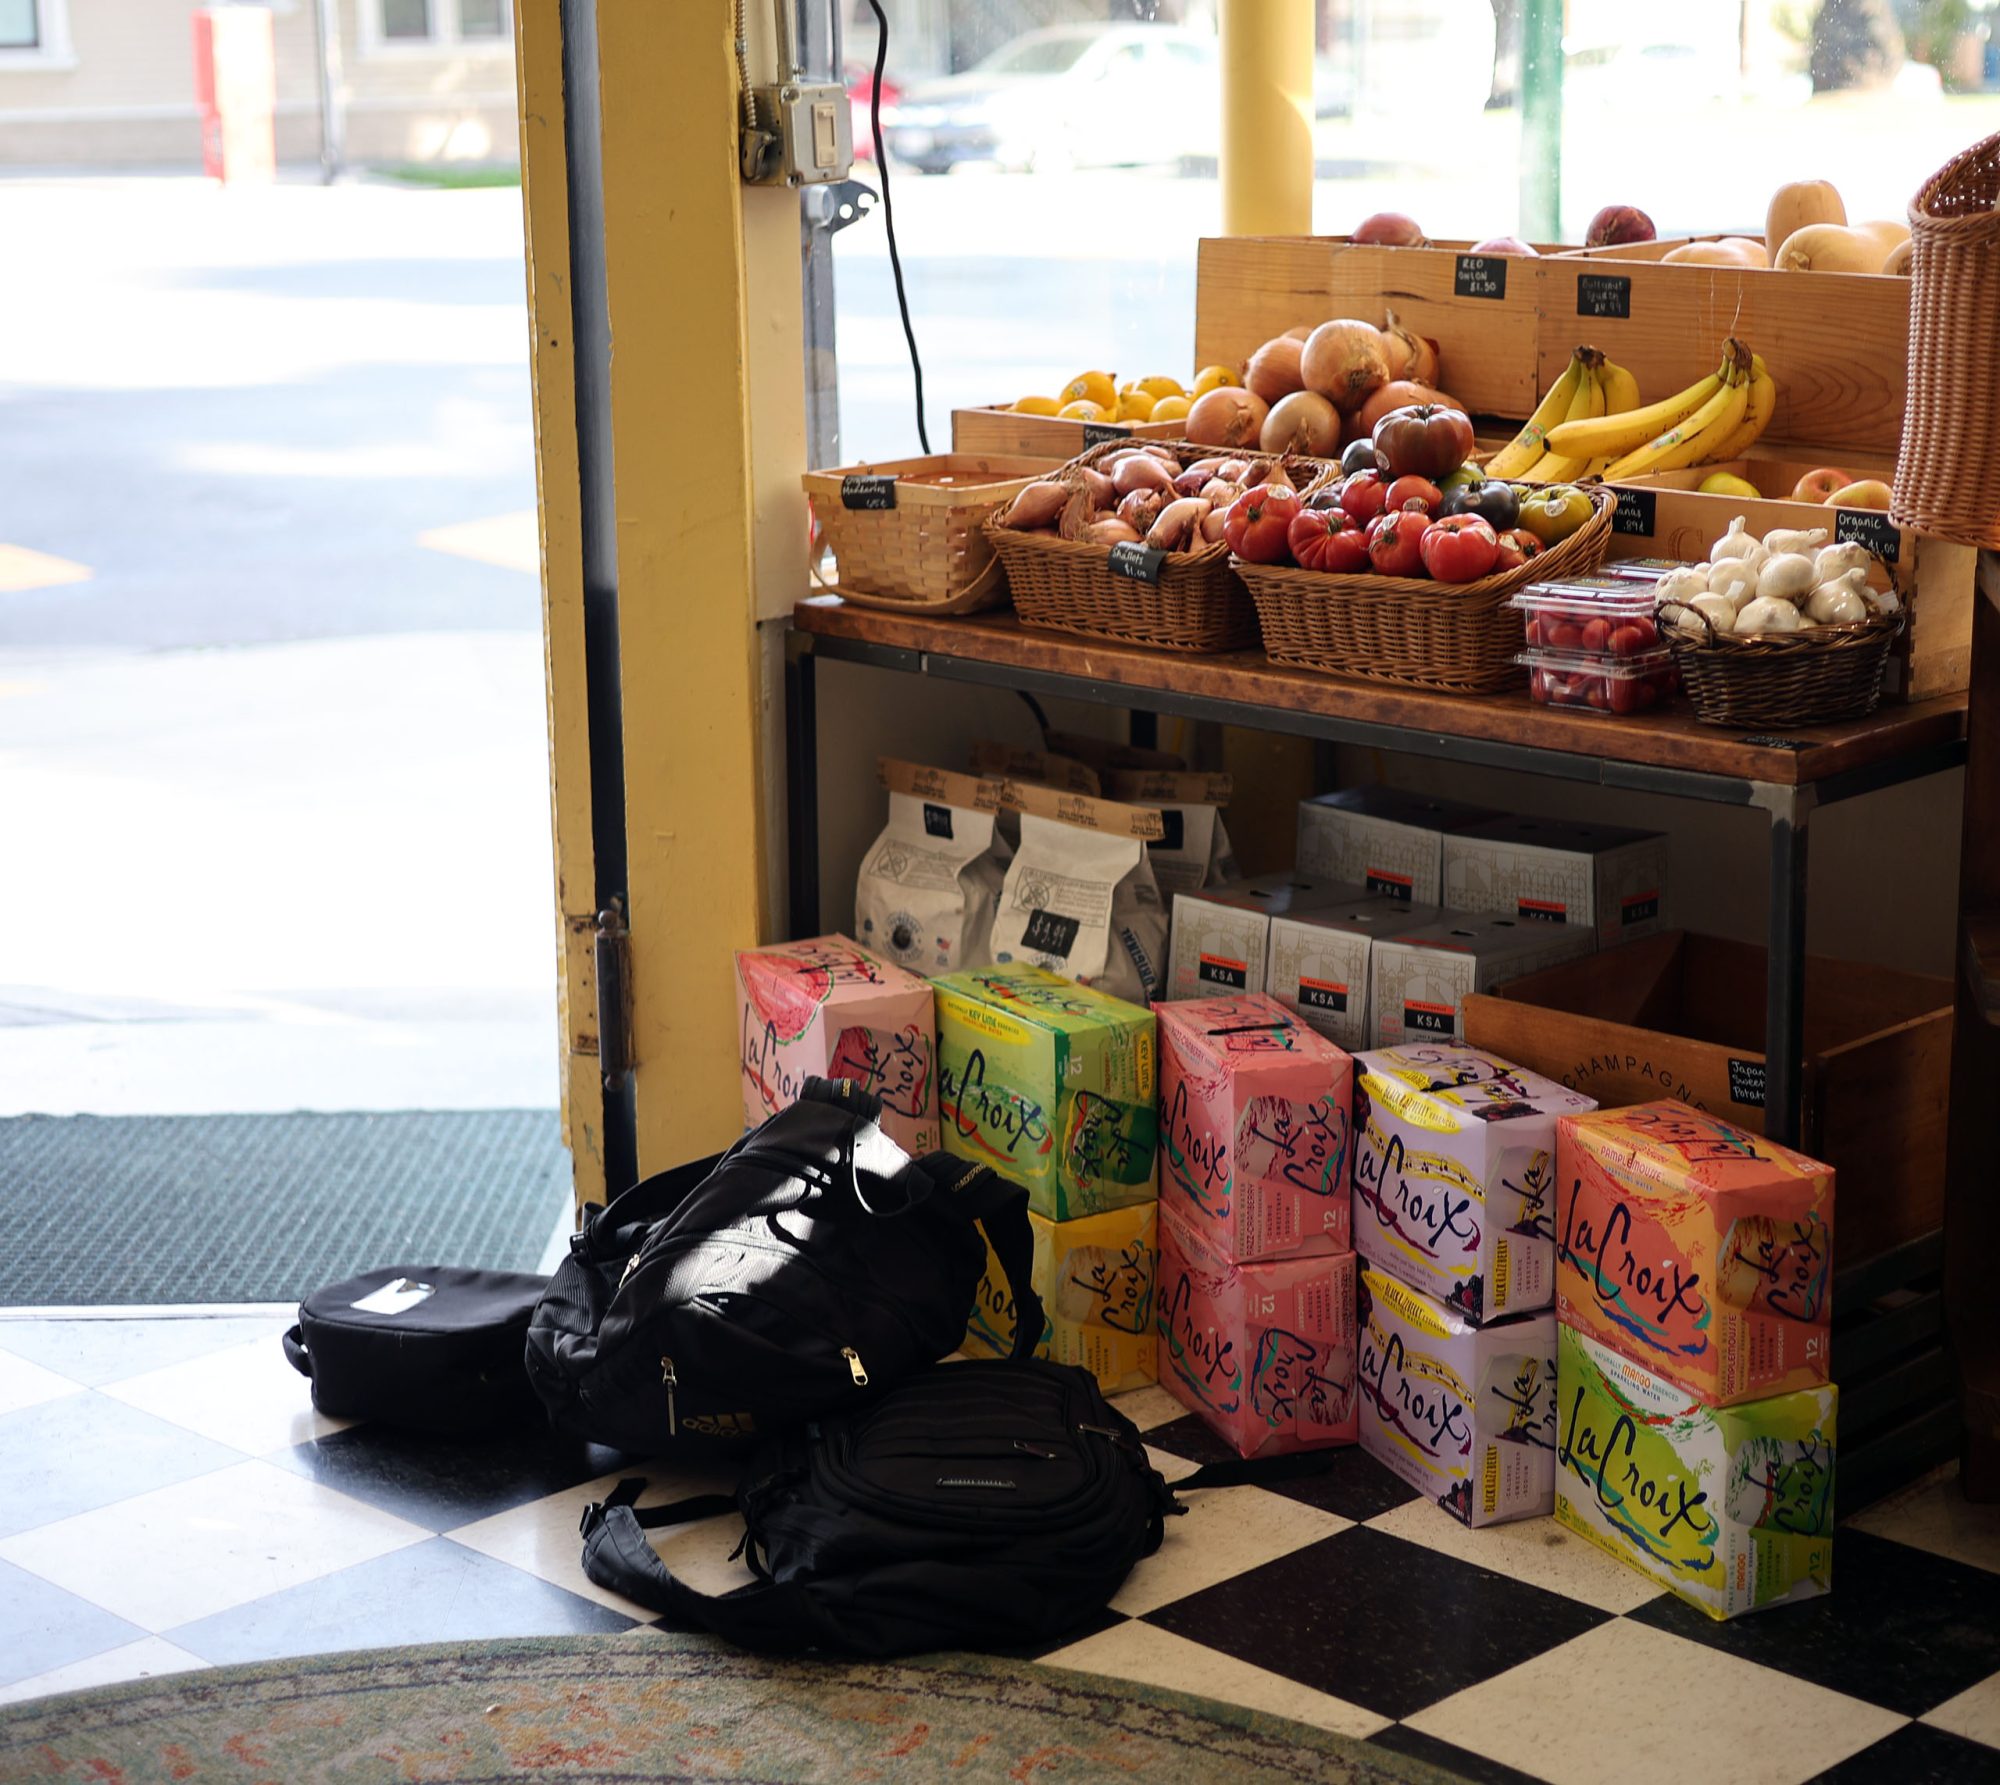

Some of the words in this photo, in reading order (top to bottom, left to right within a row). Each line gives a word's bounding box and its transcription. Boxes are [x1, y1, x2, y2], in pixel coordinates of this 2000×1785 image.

[1458, 270, 1488, 281] ONION
[1617, 490, 1637, 504] anic
[1838, 513, 1882, 531] Organic
[1838, 528, 1867, 542] Apple
[1111, 547, 1144, 565] Shallots
[1868, 539, 1895, 554] $1.00
[1377, 882, 1401, 897] KSA
[1032, 914, 1067, 947] $9.99
[1121, 927, 1157, 986] ORIGINAL
[1210, 968, 1234, 983] KSA
[1310, 992, 1335, 1006] KSA
[969, 1008, 981, 1021] KEY
[1417, 1014, 1442, 1028] KSA
[741, 1002, 806, 1106] LaCroi
[1140, 1039, 1149, 1060] KEY
[1070, 1055, 1083, 1075] 12
[1140, 1062, 1149, 1091] LIME
[1732, 1074, 1766, 1088] Sweet
[916, 1131, 928, 1150] 12
[1158, 1080, 1229, 1190] aCroix
[1600, 1144, 1662, 1182] PAMPLEMOUSSE
[1352, 1130, 1474, 1249] LaCroix
[1502, 1166, 1552, 1209] La
[1324, 1209, 1337, 1230] 12
[1556, 1178, 1704, 1324] LaCroix
[1766, 1220, 1821, 1324] Croix
[1261, 1294, 1275, 1315] 12
[1558, 1294, 1568, 1310] 12
[1157, 1270, 1237, 1384] aCroix
[1727, 1314, 1737, 1395] PAMPLEMOUSSE
[1806, 1336, 1818, 1360] 12
[1594, 1350, 1622, 1369] NATURALLY
[1621, 1363, 1652, 1389] MANGO
[1651, 1383, 1679, 1403] ESSENCED
[1610, 1368, 1640, 1390] SPARKLING
[1642, 1384, 1661, 1402] WATER
[1491, 1373, 1541, 1416] La
[1557, 1386, 1712, 1537] LaCroix
[1558, 1494, 1569, 1510] 12
[1737, 1552, 1746, 1590] MANGO
[1808, 1551, 1820, 1572] 12
